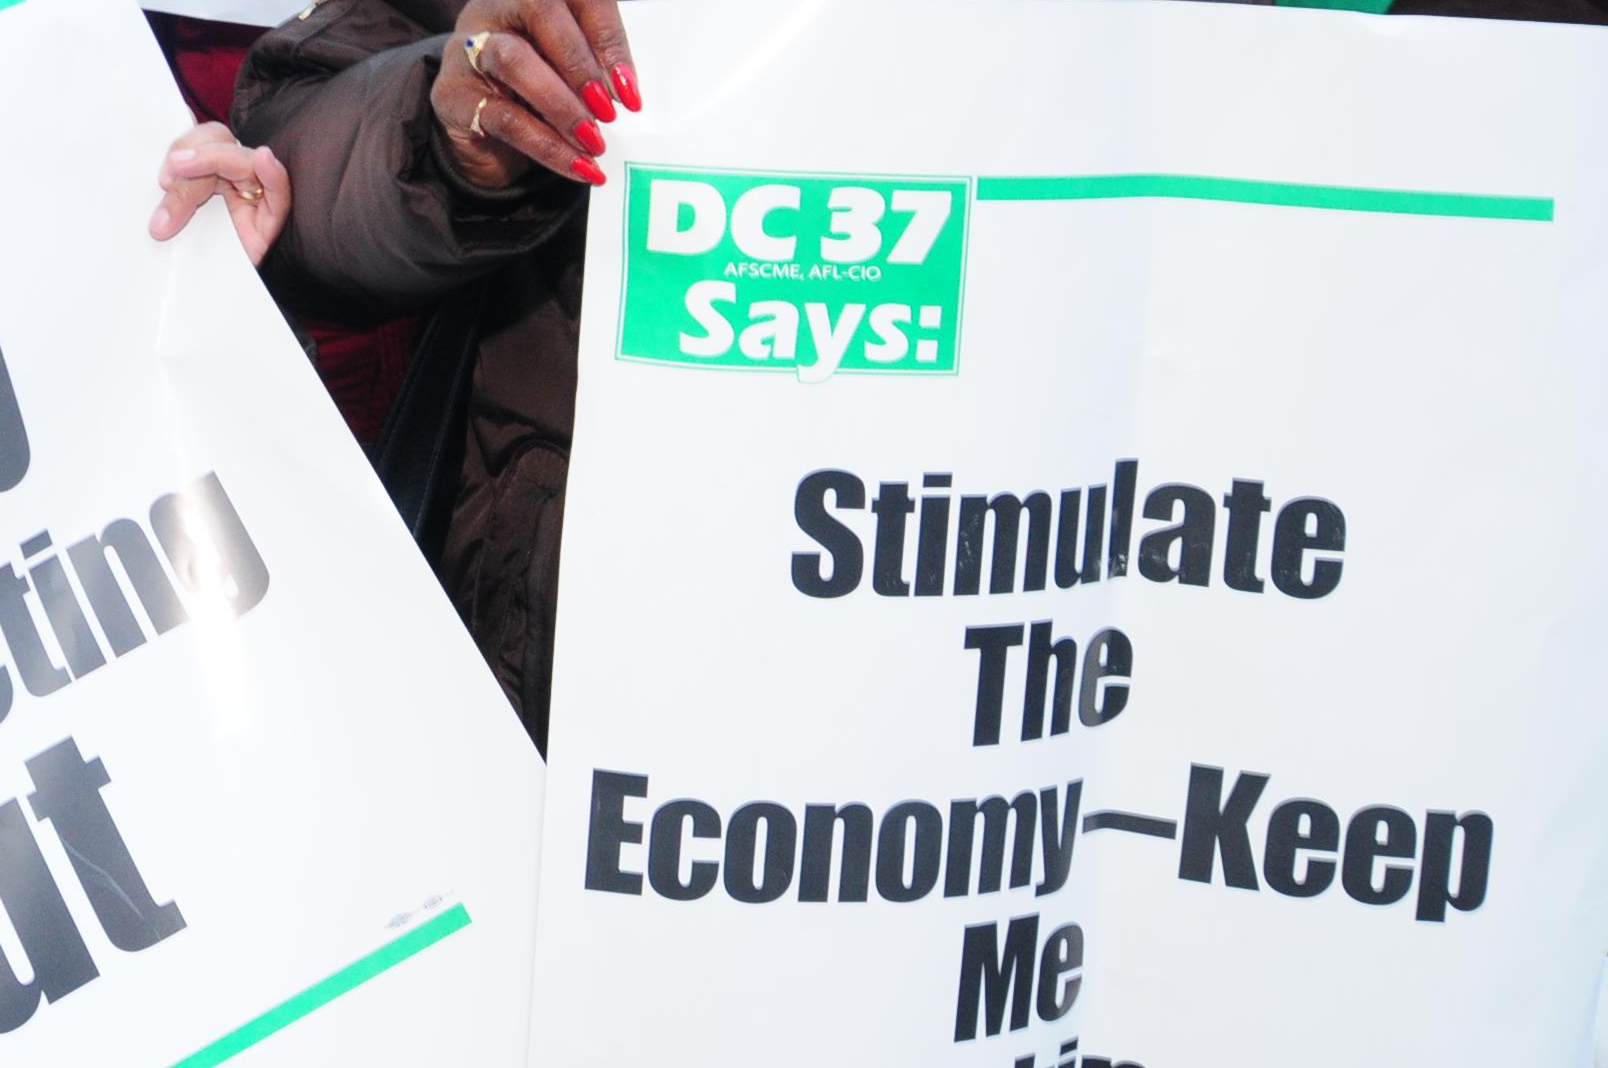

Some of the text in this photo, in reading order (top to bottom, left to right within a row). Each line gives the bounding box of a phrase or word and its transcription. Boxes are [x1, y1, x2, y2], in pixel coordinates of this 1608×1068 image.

[646, 178, 953, 265] DC 37
[807, 265, 882, 282] AFL-CIO
[679, 280, 943, 383] Says:
[790, 457, 1348, 600] Stimulate
[963, 616, 1134, 748] The
[953, 912, 1086, 1044] Me
